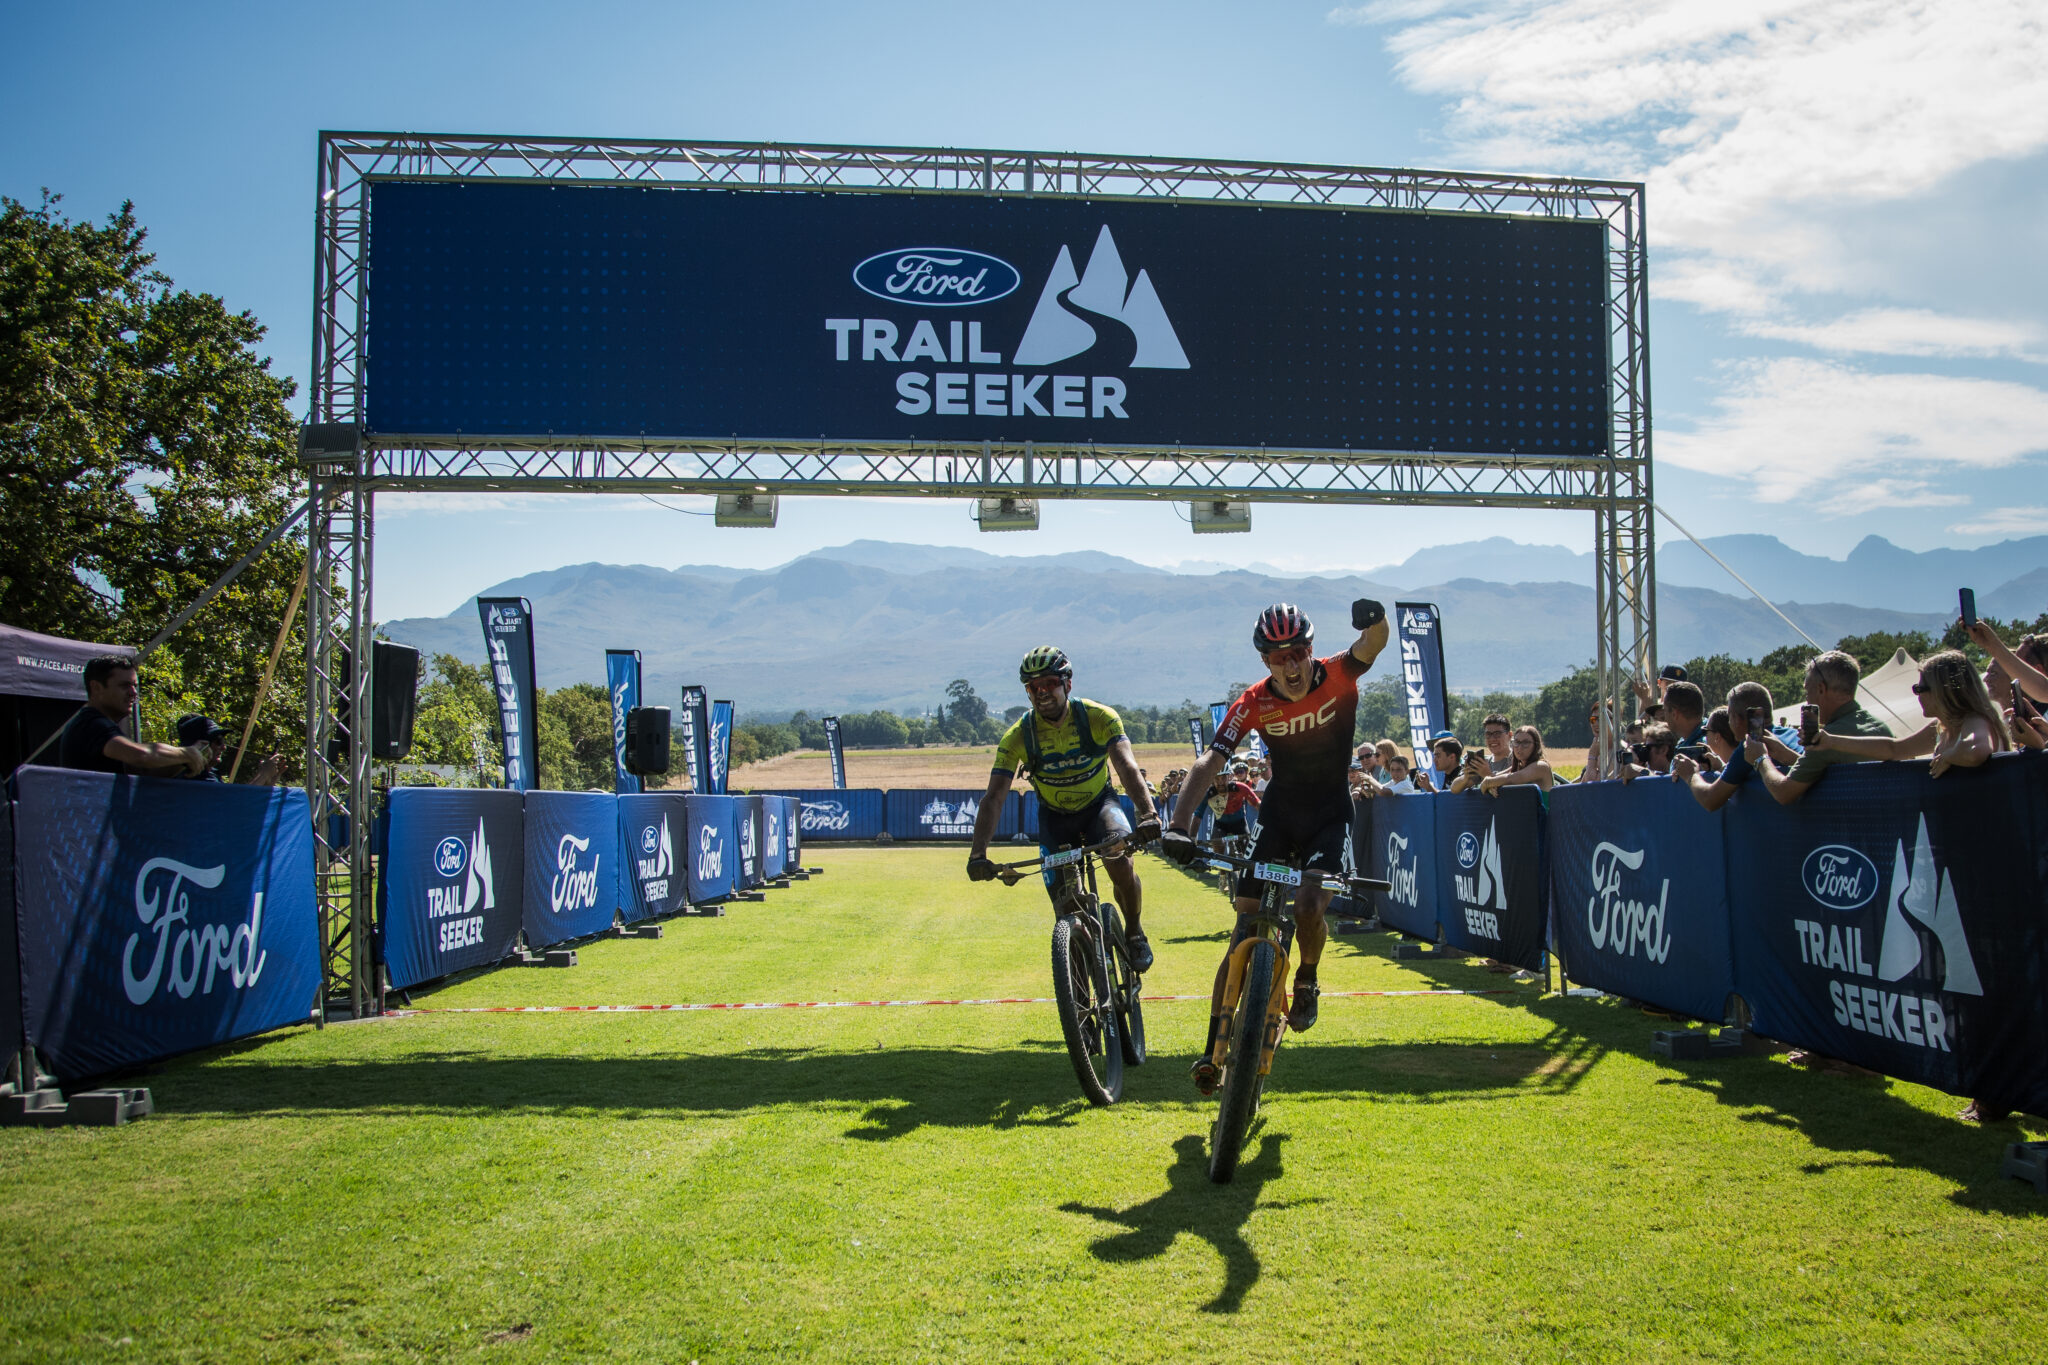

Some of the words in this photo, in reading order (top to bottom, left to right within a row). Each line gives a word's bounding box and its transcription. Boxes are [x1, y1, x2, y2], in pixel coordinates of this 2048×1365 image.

[886, 254, 988, 298] Ford
[825, 318, 1001, 364] TRAIL
[895, 371, 1130, 419] SEEKER
[1223, 703, 1250, 743] BMC
[1265, 695, 1337, 737] BMC
[1043, 755, 1092, 771] KMC
[920, 815, 952, 824] TRAIL
[932, 825, 975, 834] SEEKER
[440, 841, 462, 871] Ford
[699, 824, 723, 881] Ford
[1387, 831, 1419, 909] Ford
[1459, 836, 1475, 863] Ford
[551, 833, 599, 913] Ford
[1258, 869, 1299, 885] 13869
[1455, 874, 1477, 904] TRAIL
[1814, 852, 1863, 899] Ford
[428, 885, 463, 919] TRAIL
[1588, 841, 1672, 965] Ford
[122, 857, 267, 1006] Ford
[439, 916, 484, 953] SEEKER
[1794, 918, 1873, 976] TRAIL
[1829, 979, 1951, 1053] SEEKER
